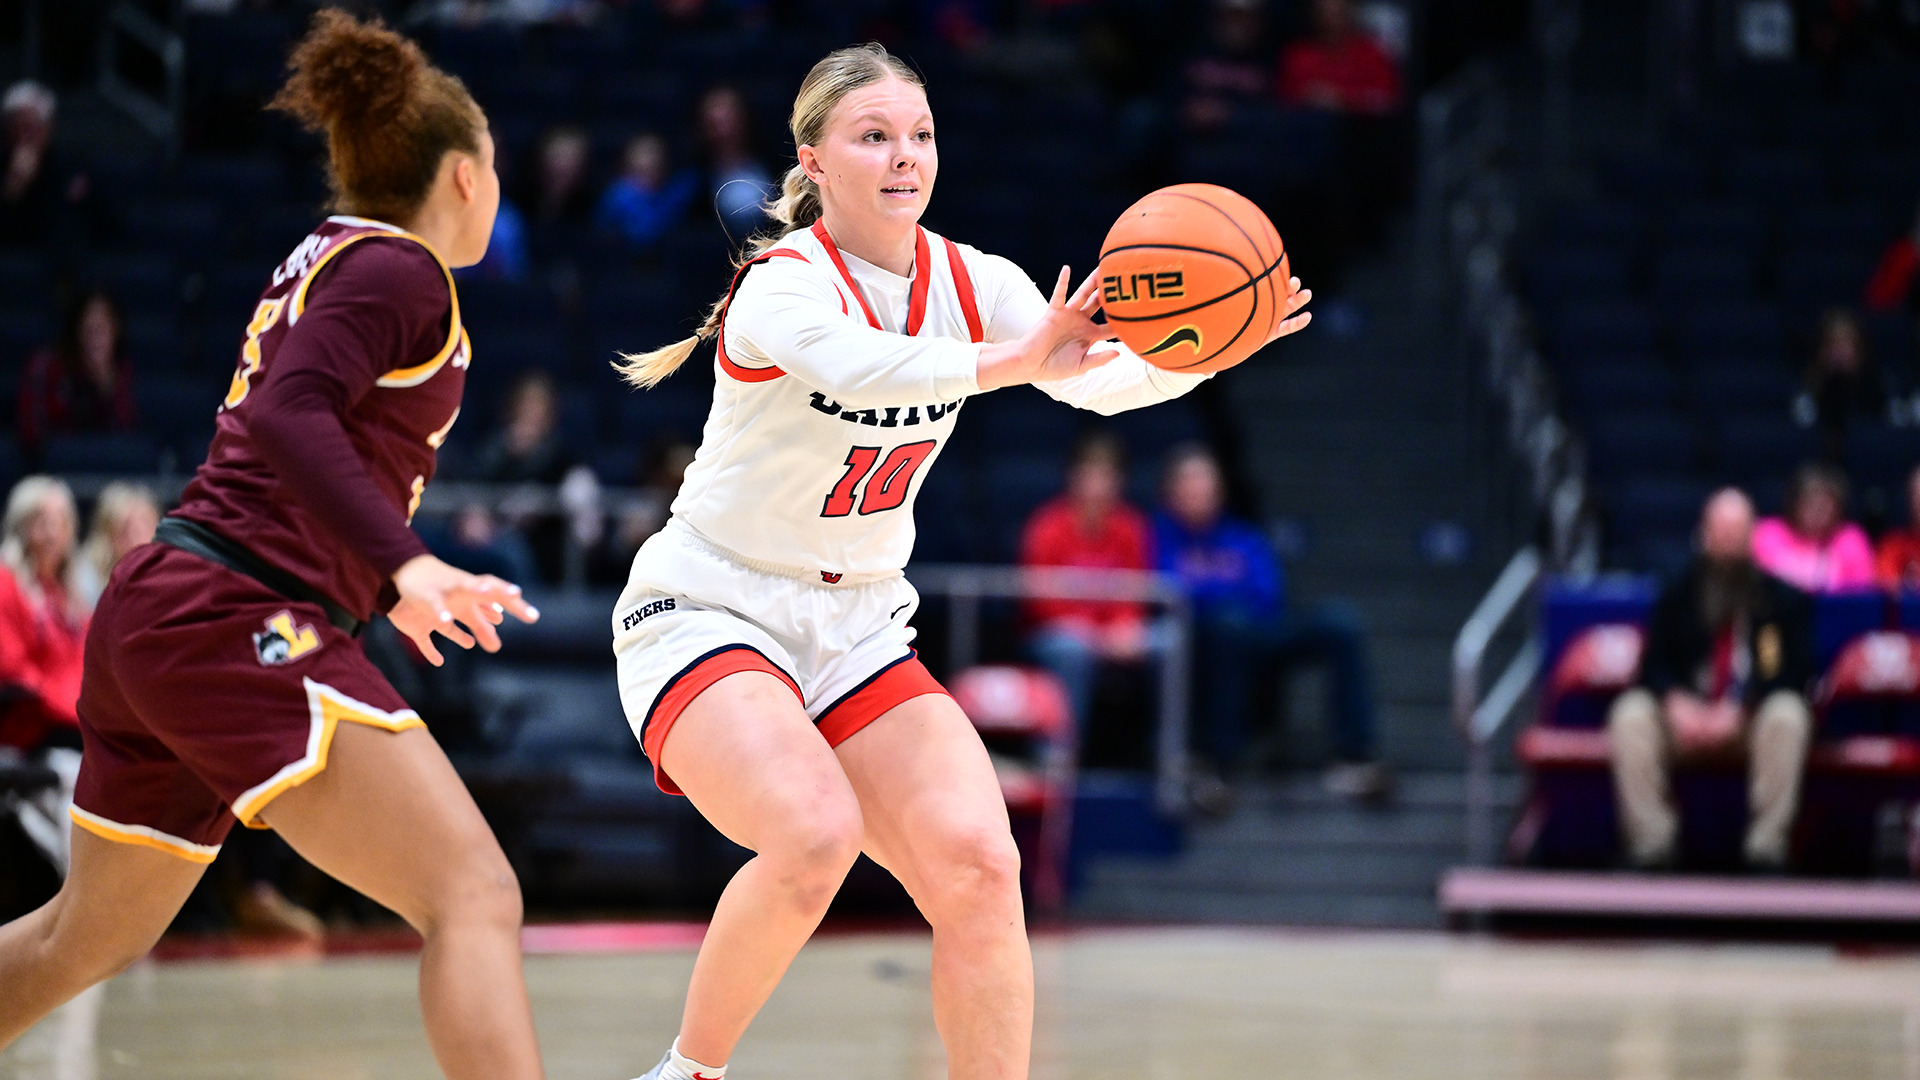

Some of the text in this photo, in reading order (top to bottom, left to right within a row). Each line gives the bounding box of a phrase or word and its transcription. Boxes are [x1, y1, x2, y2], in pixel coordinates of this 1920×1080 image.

[1103, 271, 1184, 303] ELITE
[820, 439, 937, 518] 10
[622, 597, 676, 631] FLYERS
